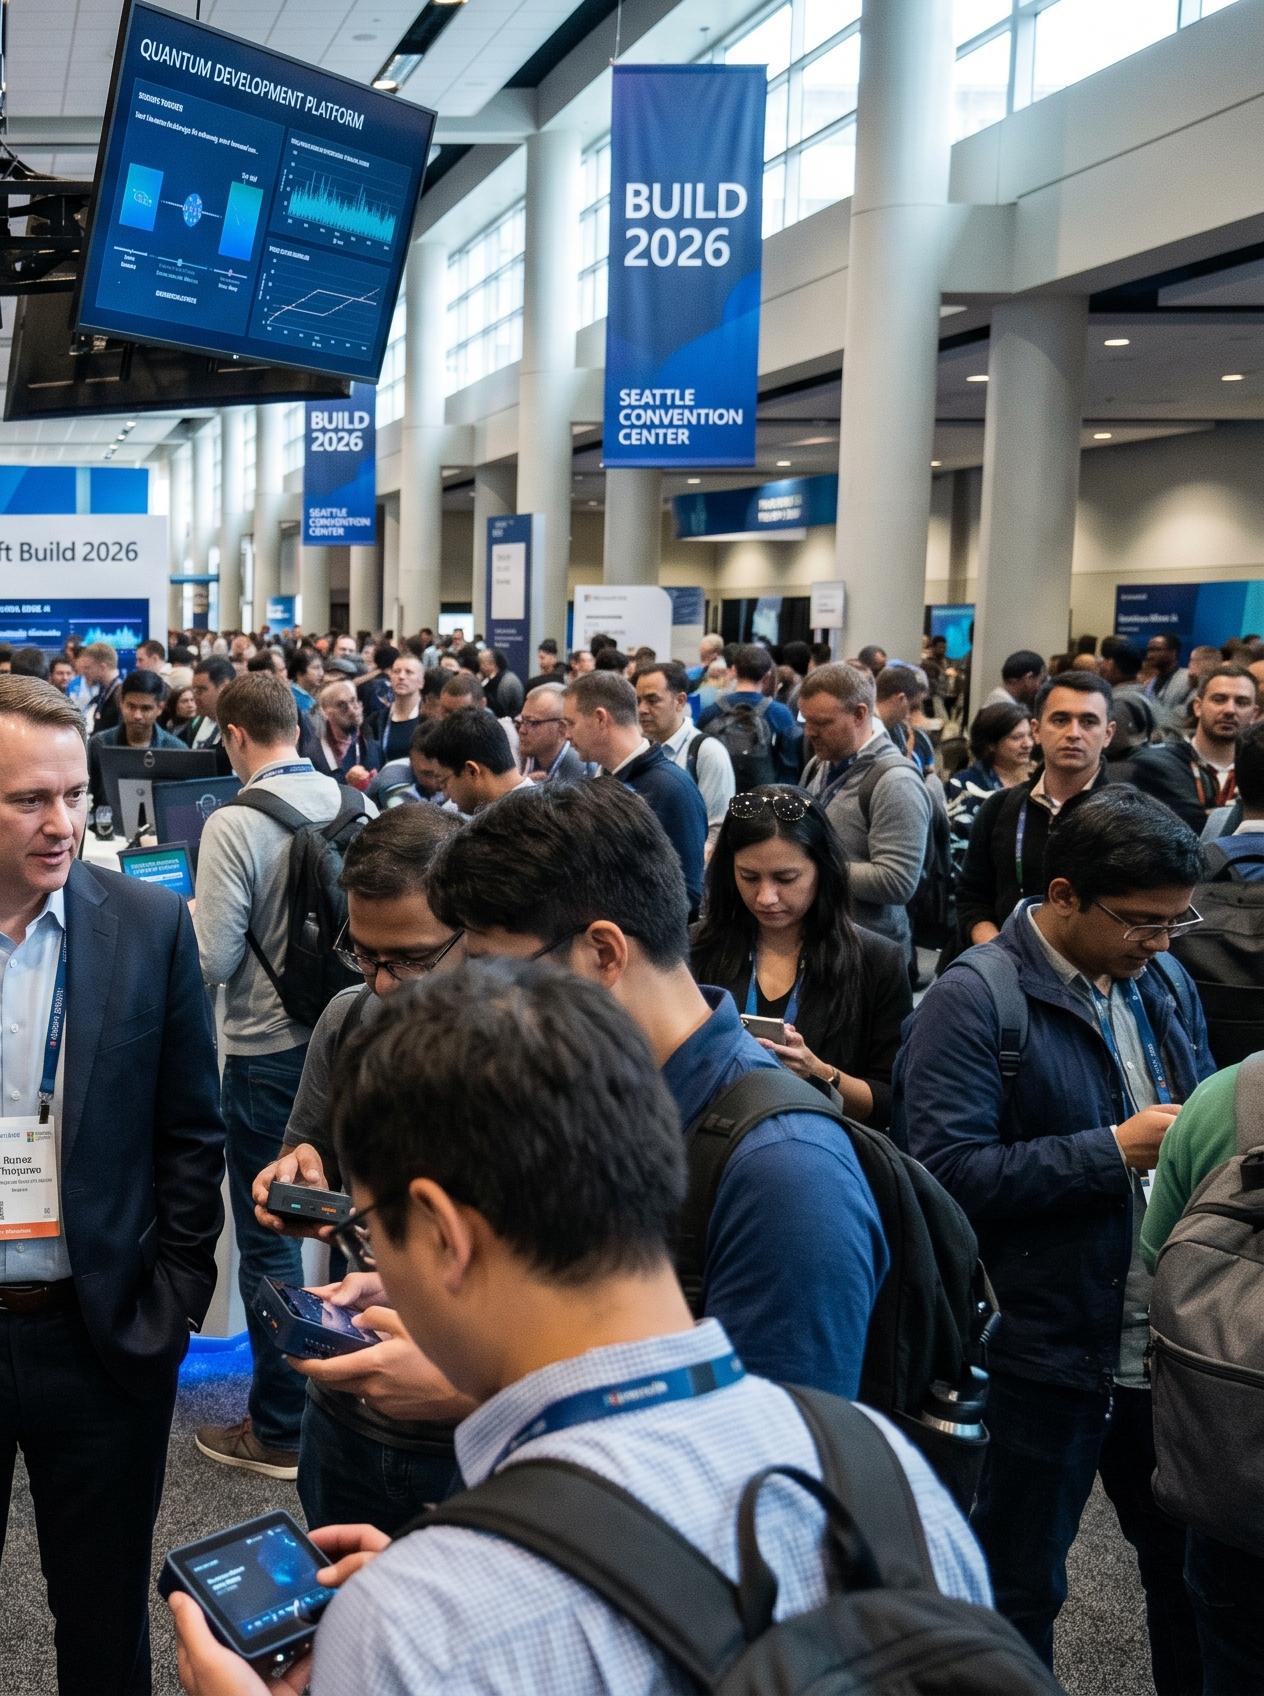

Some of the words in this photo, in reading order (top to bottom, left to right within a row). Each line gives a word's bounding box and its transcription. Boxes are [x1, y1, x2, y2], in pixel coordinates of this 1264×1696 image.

[140, 38, 212, 79] QUANTUM
[214, 63, 304, 110] DEVELOPMENT
[305, 95, 365, 131] PLATFORM
[625, 182, 748, 220] BUILD
[624, 227, 731, 267] 2026
[619, 388, 695, 406] SEATTLE
[310, 411, 370, 430] BUILD
[618, 408, 743, 426] CONVENTION
[311, 431, 363, 452] 2026
[618, 428, 690, 446] CENTER
[19, 541, 76, 563] Build
[82, 541, 139, 562] 2026
